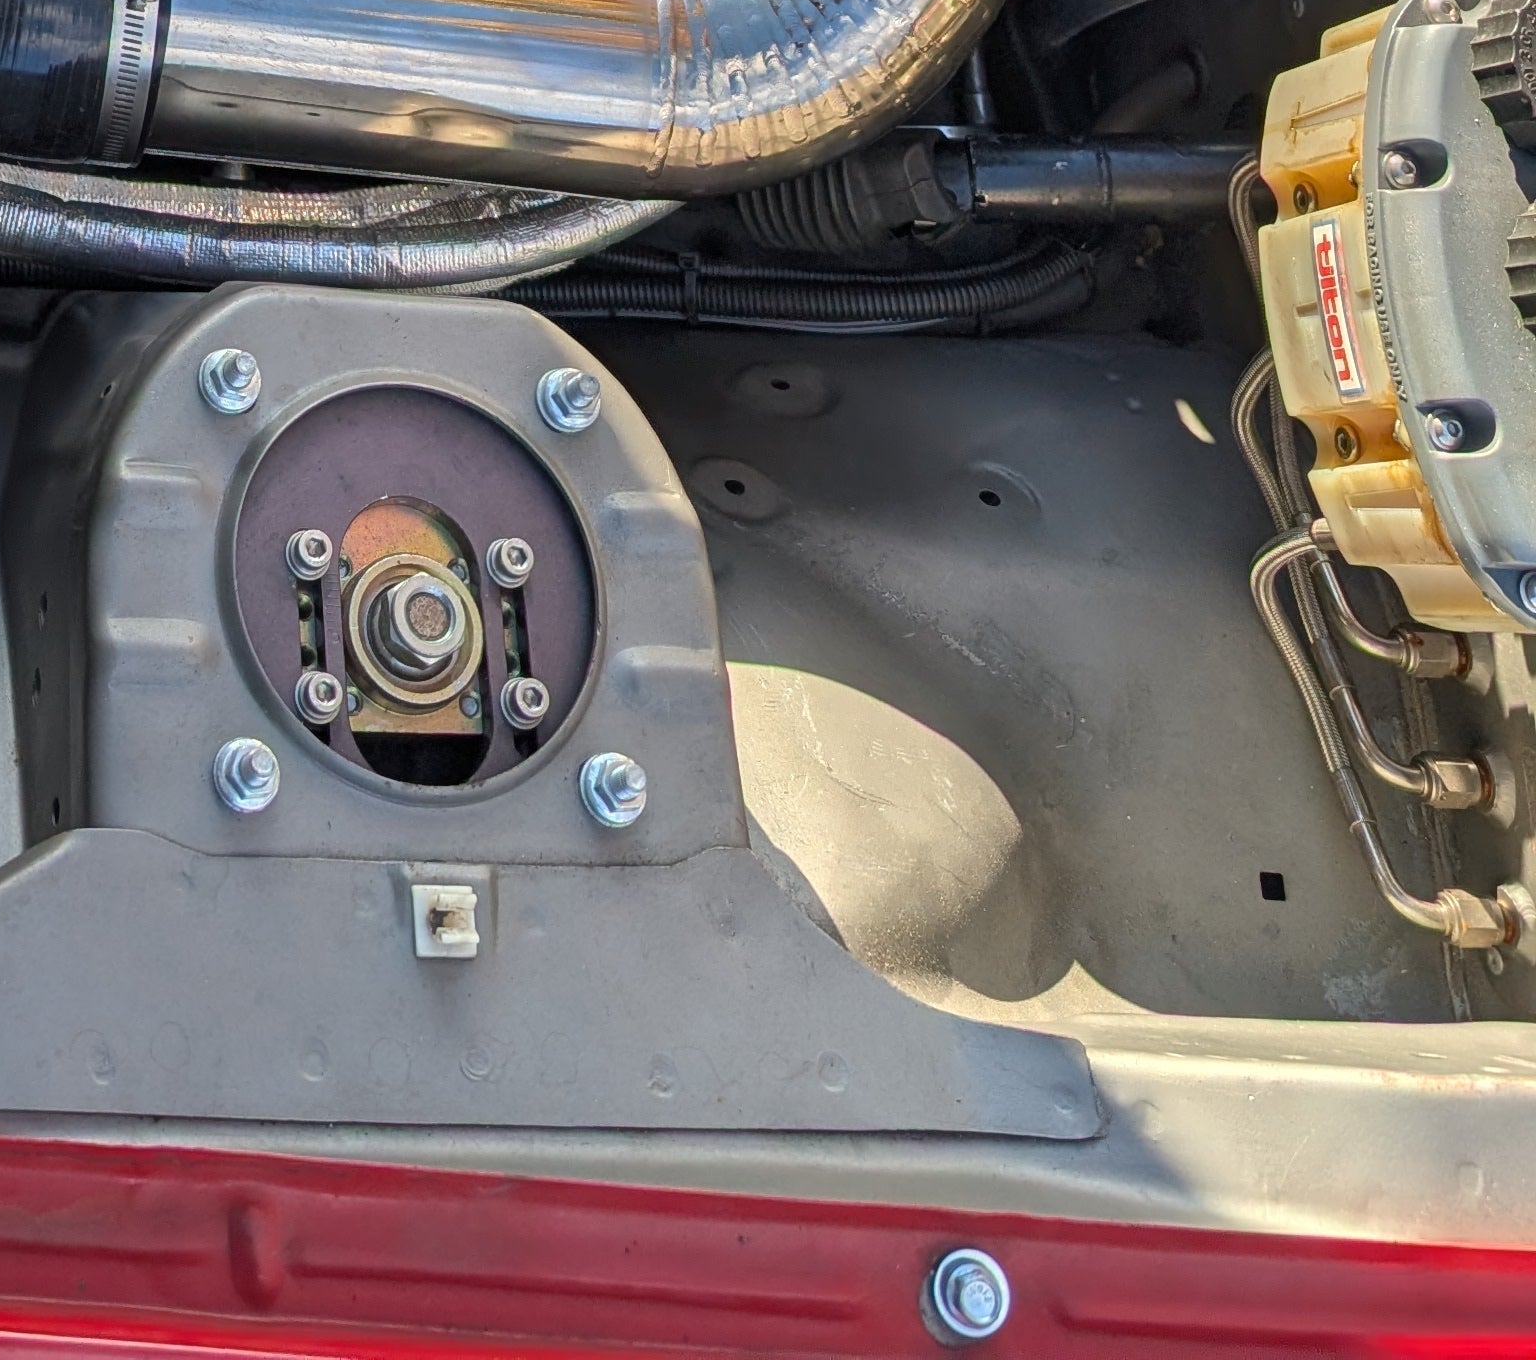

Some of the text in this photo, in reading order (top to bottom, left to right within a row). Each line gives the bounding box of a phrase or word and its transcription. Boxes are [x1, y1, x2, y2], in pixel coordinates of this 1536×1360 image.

[1316, 233, 1350, 382] tilton
[1366, 192, 1408, 403] FOR RACING USE ONLY
